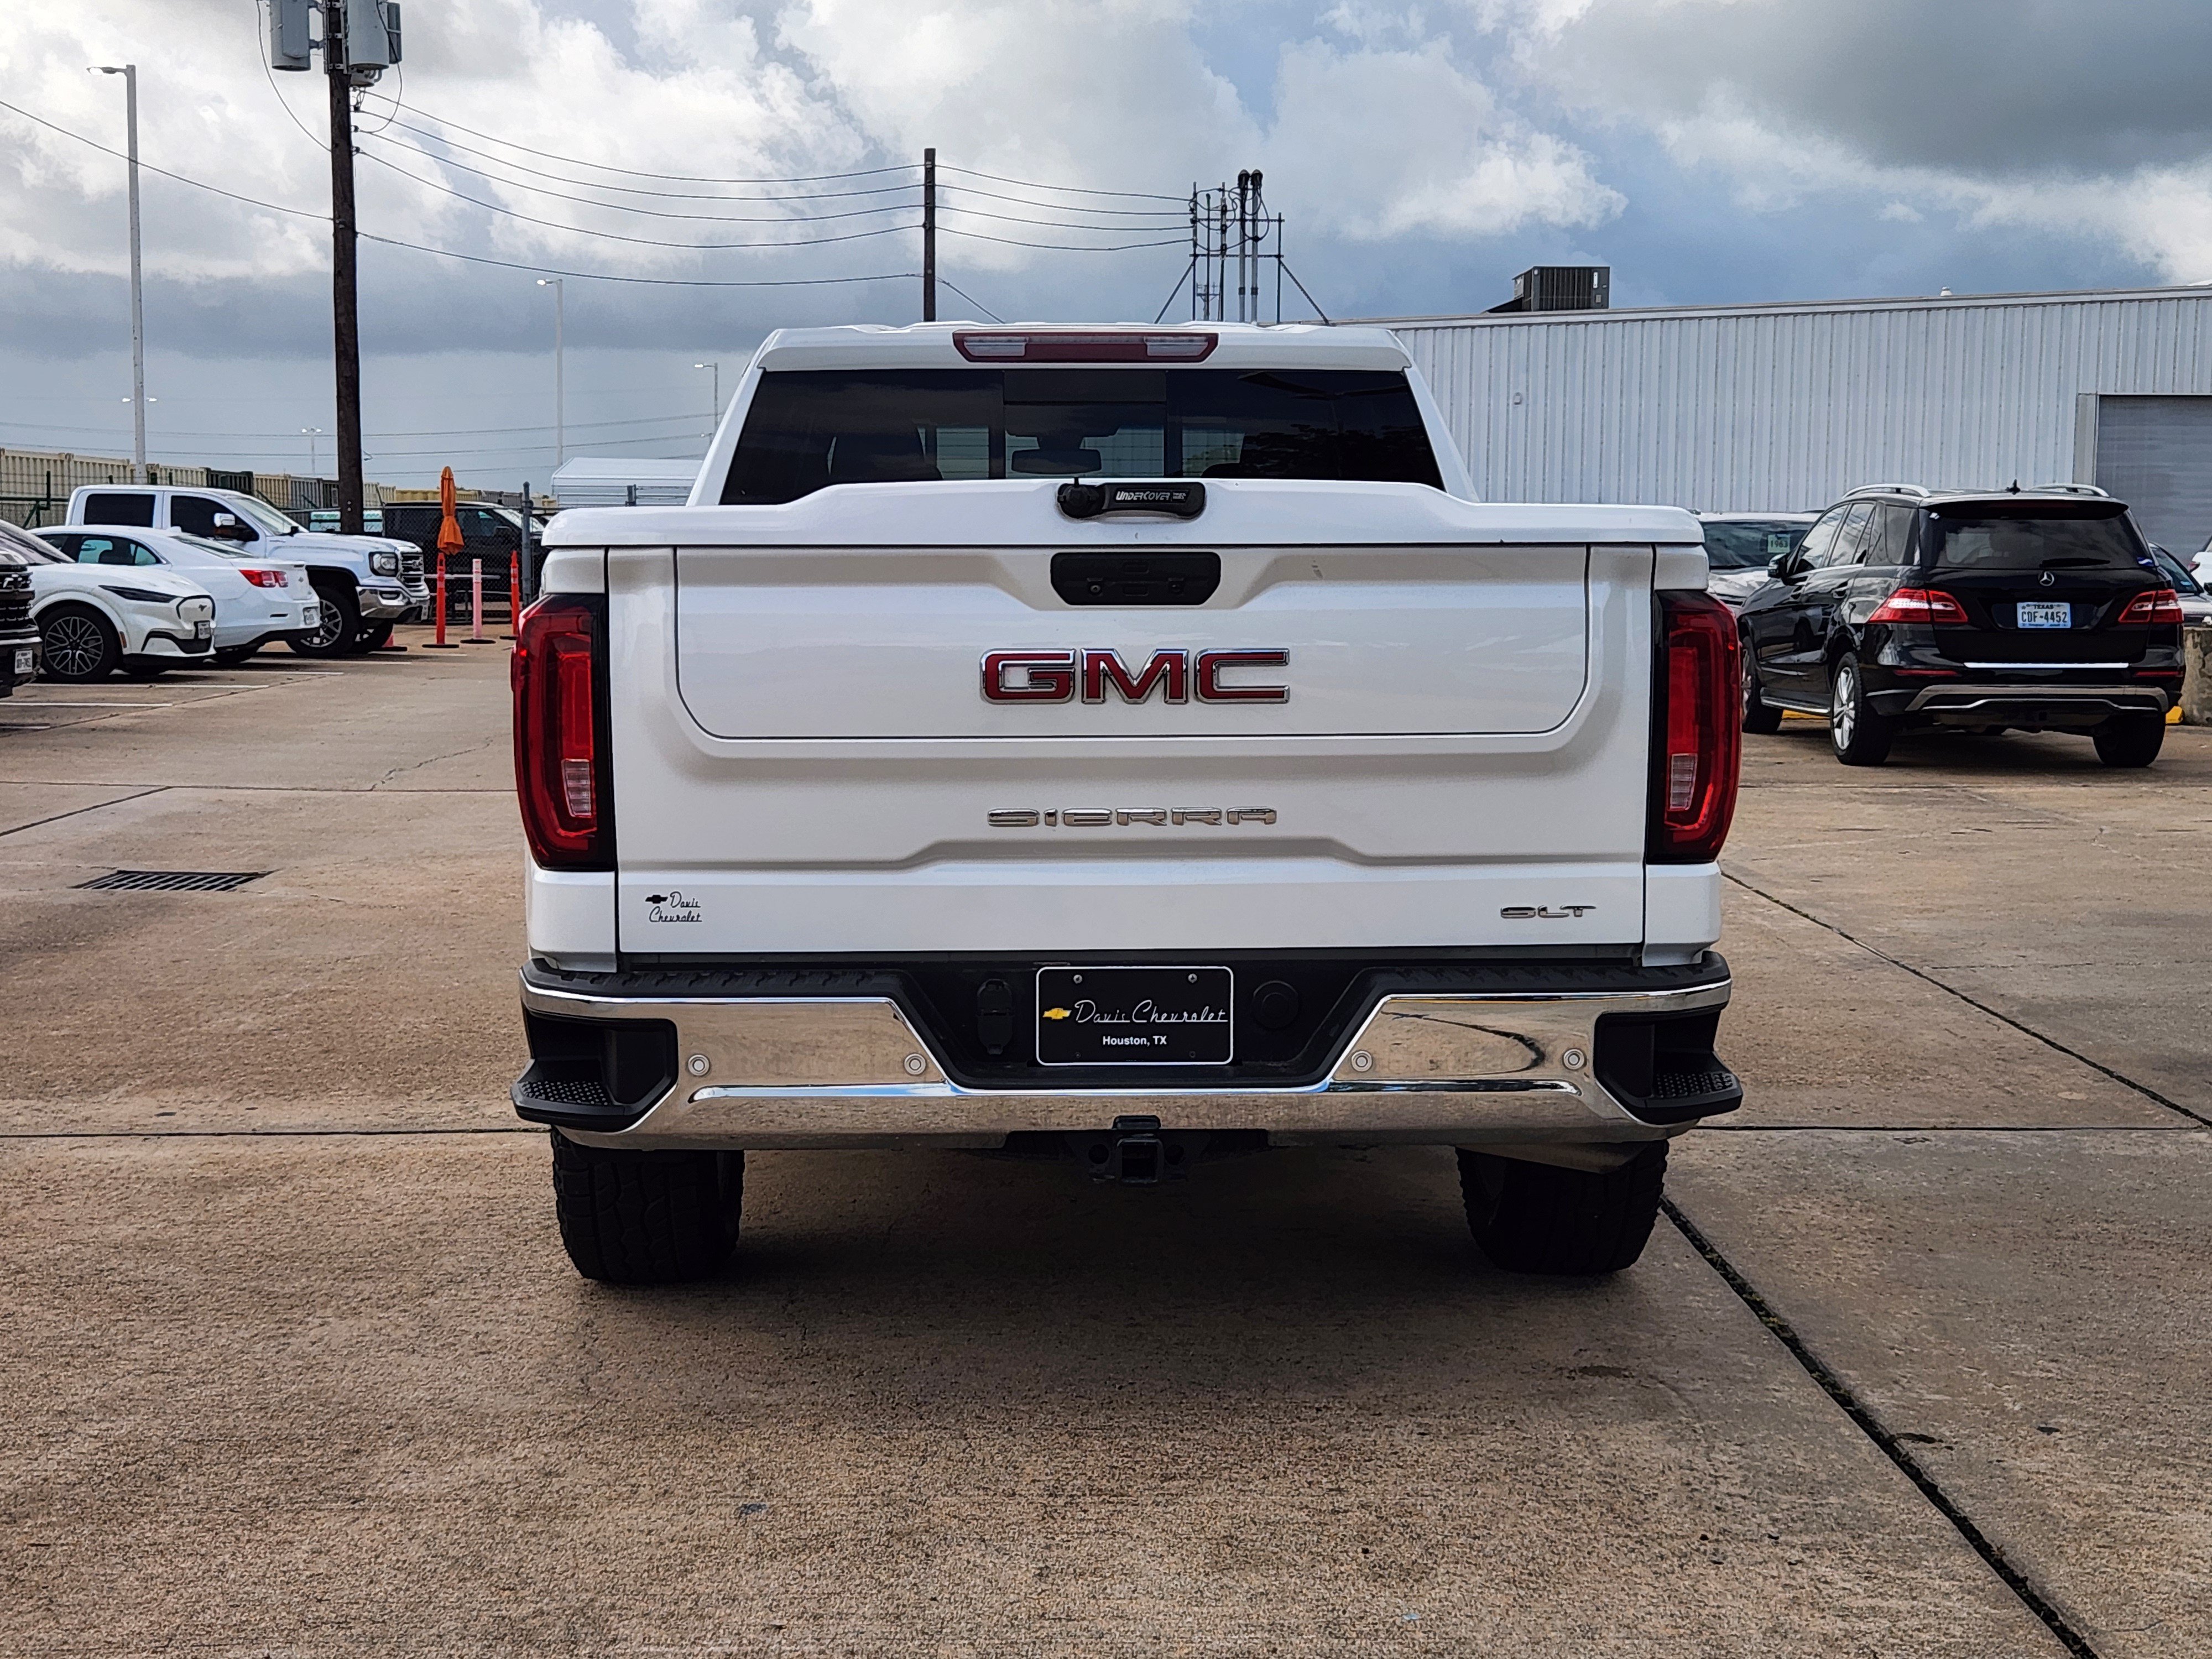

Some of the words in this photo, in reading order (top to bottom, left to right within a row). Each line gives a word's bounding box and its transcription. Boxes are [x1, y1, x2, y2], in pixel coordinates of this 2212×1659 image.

[979, 648, 1290, 704] GMC
[987, 806, 1277, 827] SIERRA
[670, 891, 701, 908] Davis
[649, 905, 702, 922] Chevrolet
[1500, 905, 1597, 919] SLT
[1074, 999, 1130, 1023] Davis
[1133, 999, 1228, 1023] Chevrolet
[1103, 1036, 1150, 1046] Houston,
[1153, 1036, 1167, 1045] TX
